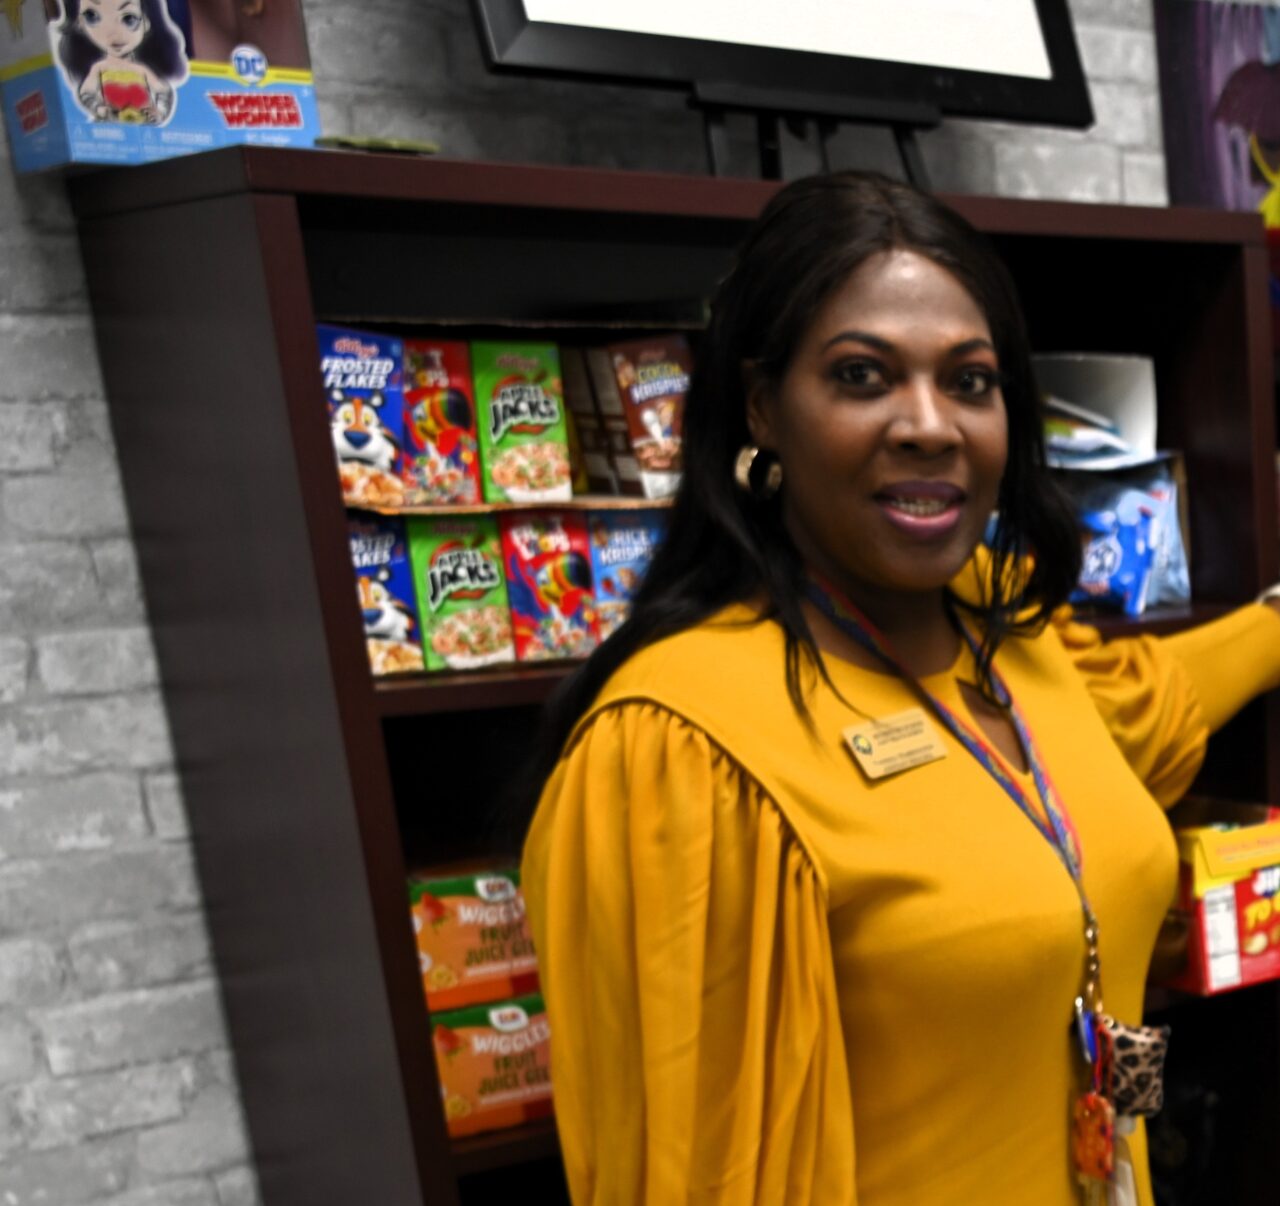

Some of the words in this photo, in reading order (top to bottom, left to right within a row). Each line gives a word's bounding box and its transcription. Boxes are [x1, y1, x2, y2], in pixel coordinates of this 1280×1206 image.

[235, 55, 265, 79] DC
[210, 91, 300, 111] WONDER
[224, 107, 303, 128] WOMAN
[321, 357, 394, 376] FROSTED
[325, 373, 387, 389] FLAKES
[490, 399, 559, 443] JACKS
[428, 563, 499, 611] JACKS
